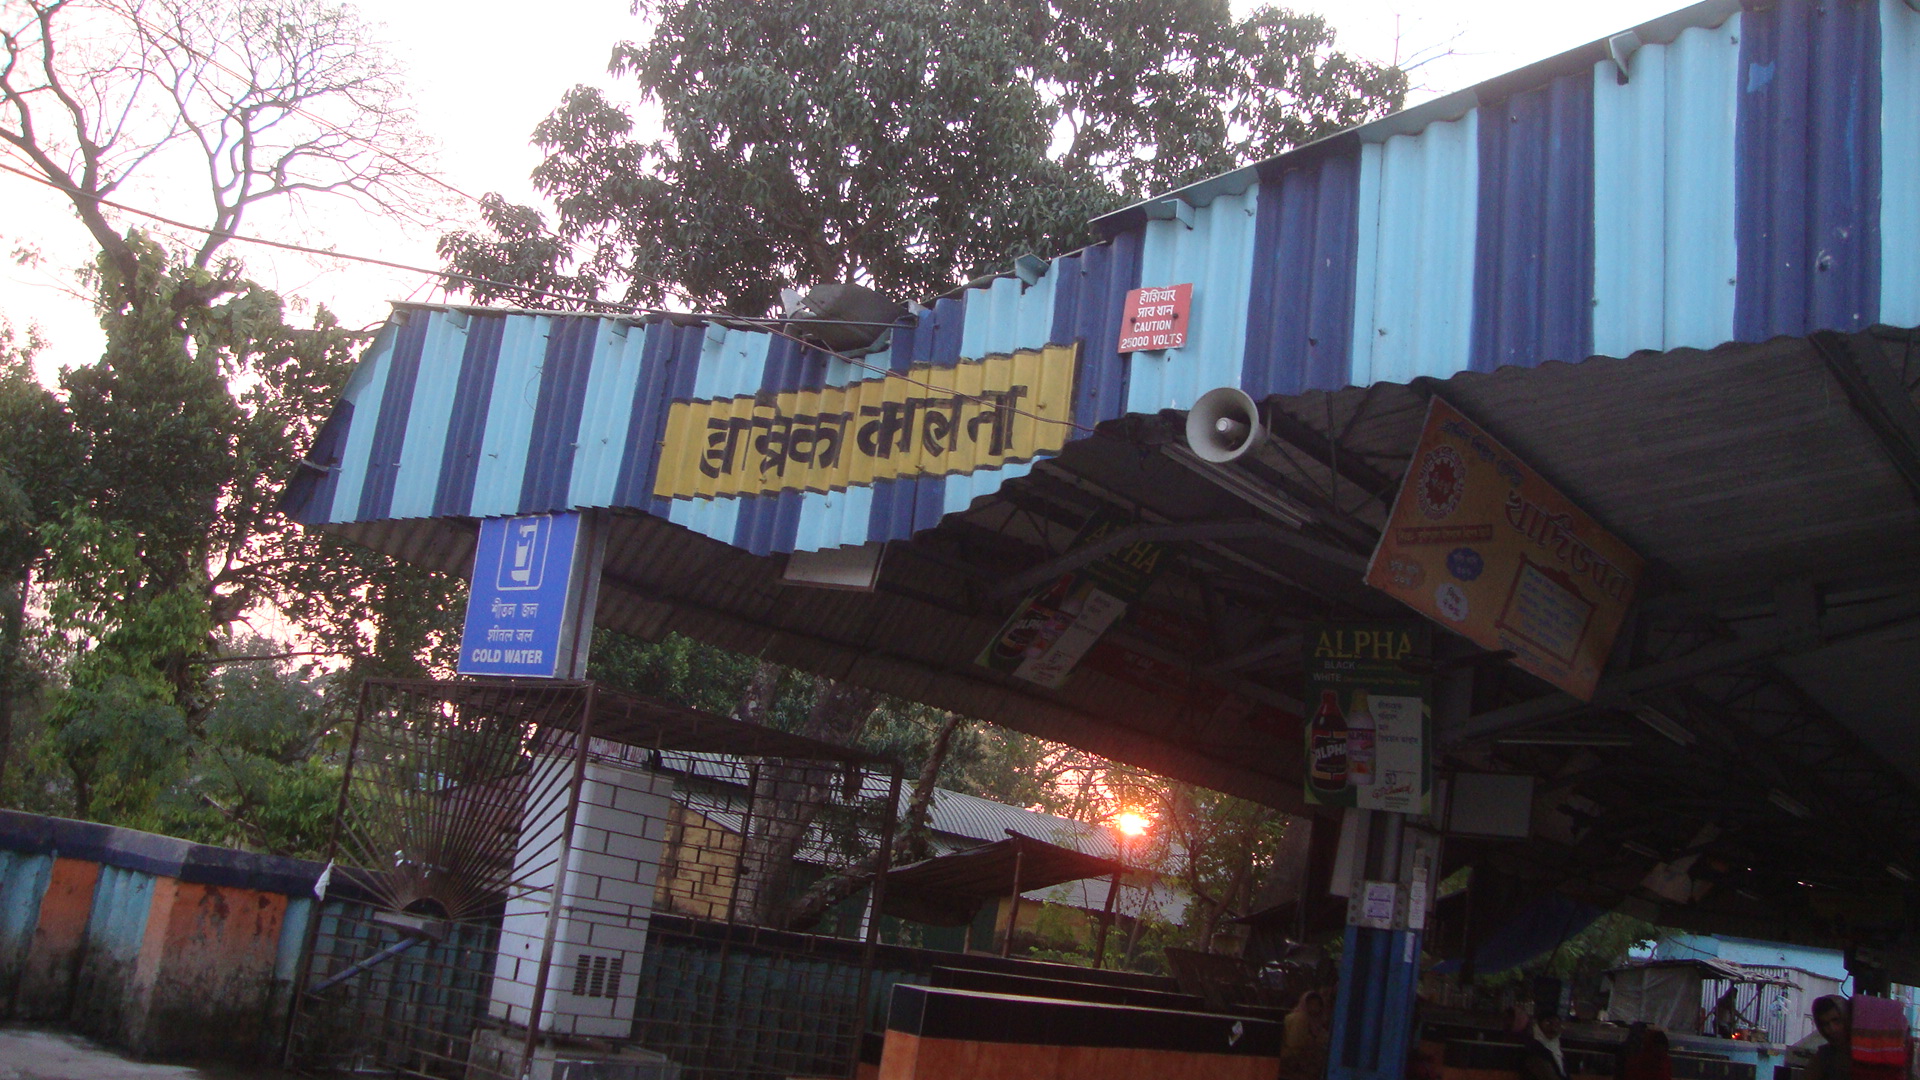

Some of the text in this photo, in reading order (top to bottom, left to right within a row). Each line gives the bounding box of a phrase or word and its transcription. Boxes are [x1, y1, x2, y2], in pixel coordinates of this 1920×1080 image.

[1139, 289, 1176, 305] होशियार
[1134, 320, 1172, 333] CAUTION
[1121, 333, 1183, 349] 25000 VOLTS
[1085, 521, 1161, 575] AHA
[487, 625, 535, 643] शीतल जल
[1314, 629, 1413, 660] ALPHA
[472, 649, 543, 664] COLD WATER
[1324, 660, 1356, 670] BLACK
[1313, 671, 1342, 682] WHITE
